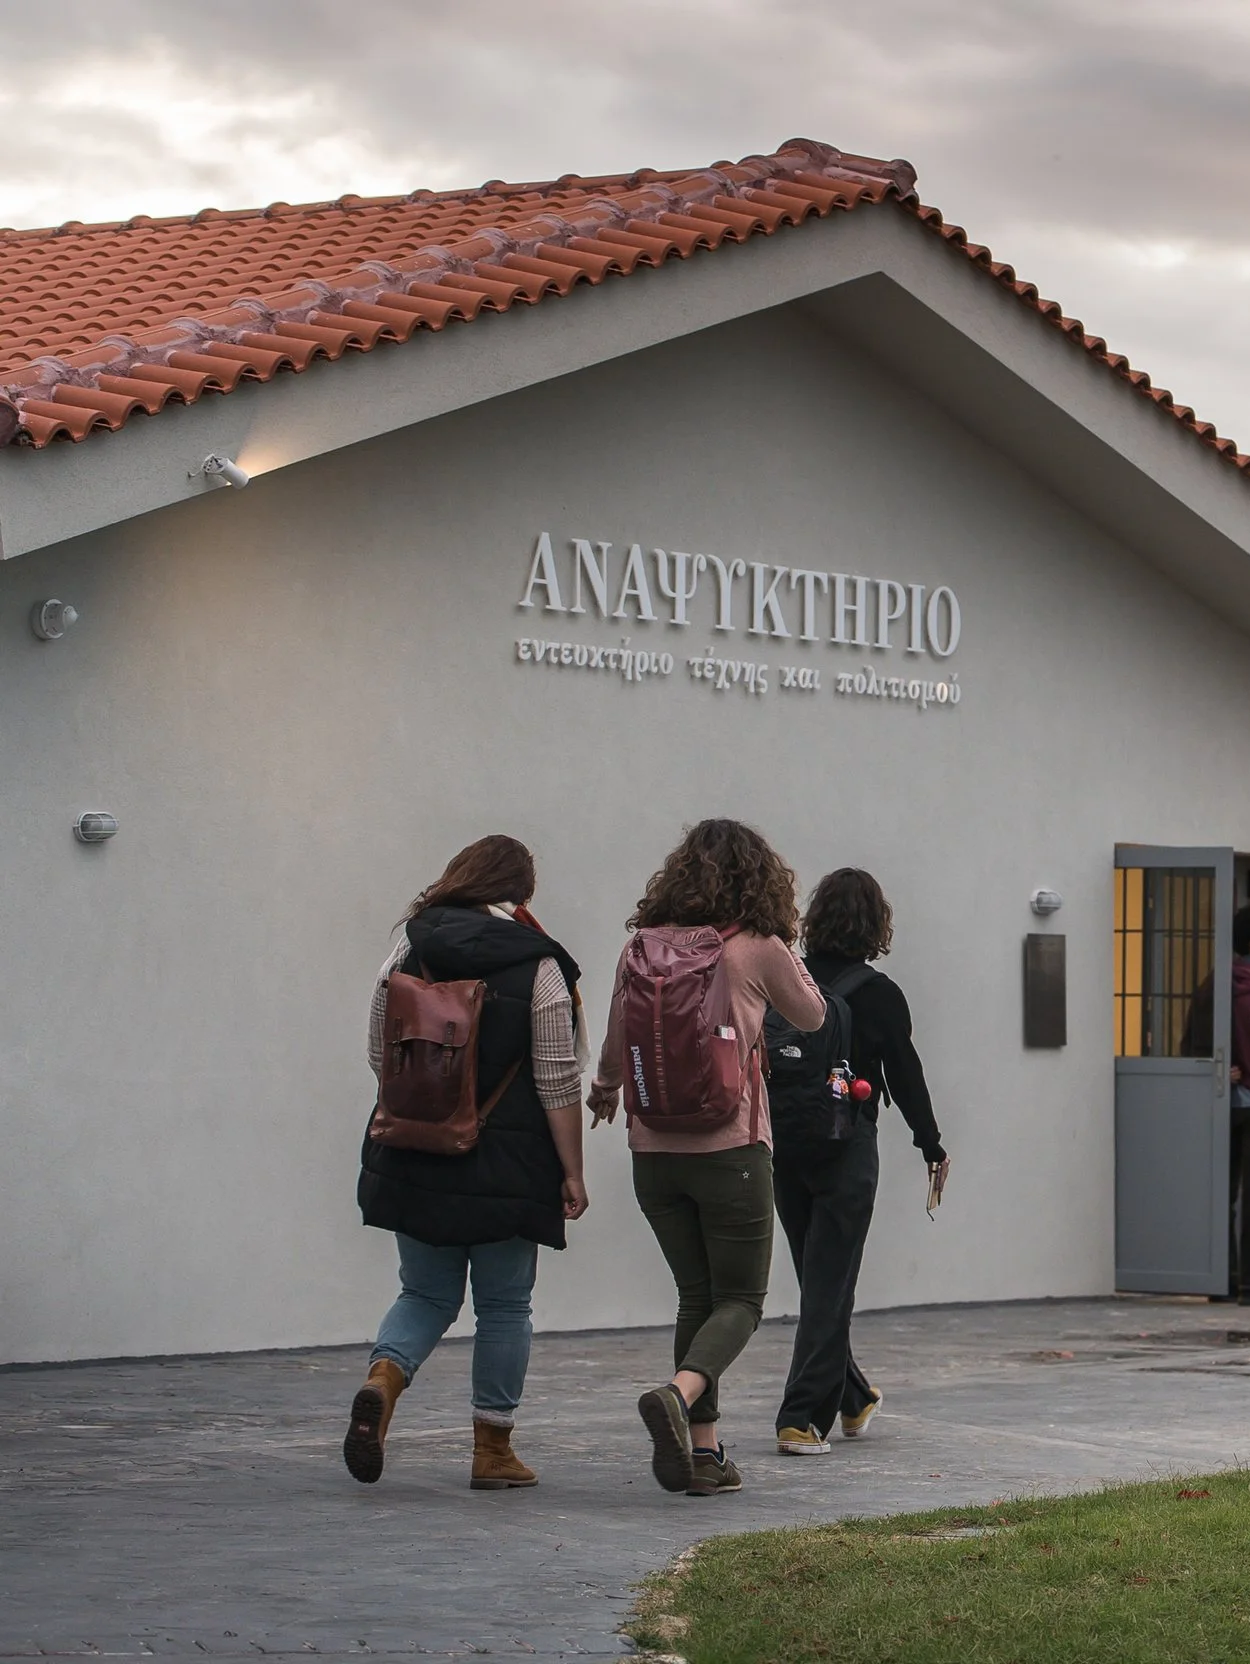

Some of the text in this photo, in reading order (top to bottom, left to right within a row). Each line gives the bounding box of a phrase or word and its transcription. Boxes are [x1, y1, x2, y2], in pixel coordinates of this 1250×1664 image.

[518, 531, 962, 658] ΑΝΑΨΥΚΤΗΡΙΟ
[516, 637, 962, 707] εντευκτήριο τέχνης και πολιτισμού
[630, 1045, 650, 1108] patagonia
